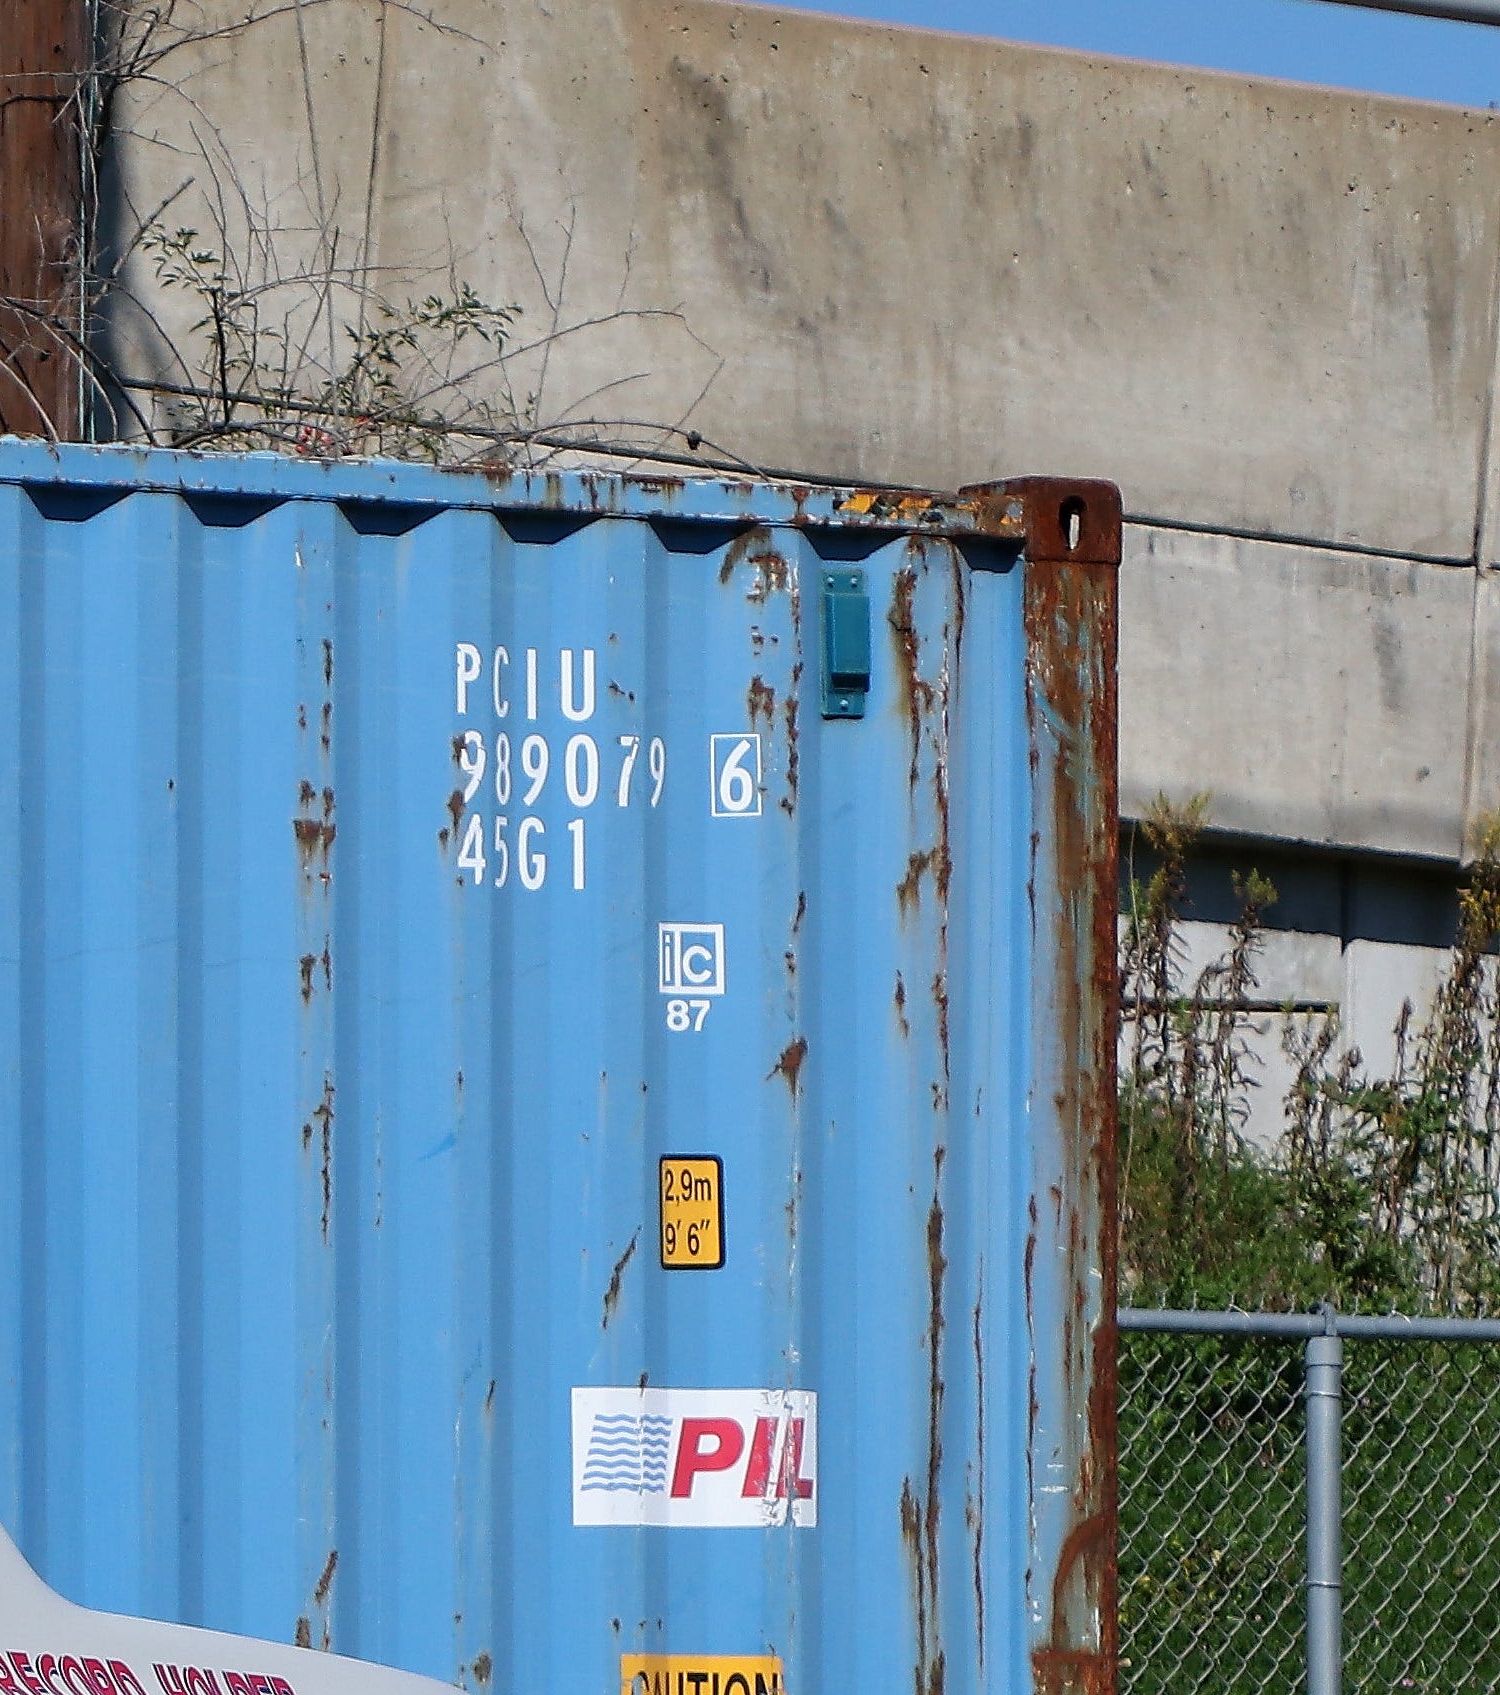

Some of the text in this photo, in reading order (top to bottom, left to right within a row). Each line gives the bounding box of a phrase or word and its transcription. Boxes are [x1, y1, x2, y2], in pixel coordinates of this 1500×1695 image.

[457, 643, 596, 720] PCIU
[460, 730, 753, 813] 989079 6
[457, 813, 585, 890] 45G1
[666, 1000, 711, 1031] 87
[664, 1168, 712, 1206] 2,9m
[670, 1417, 814, 1499] PIL
